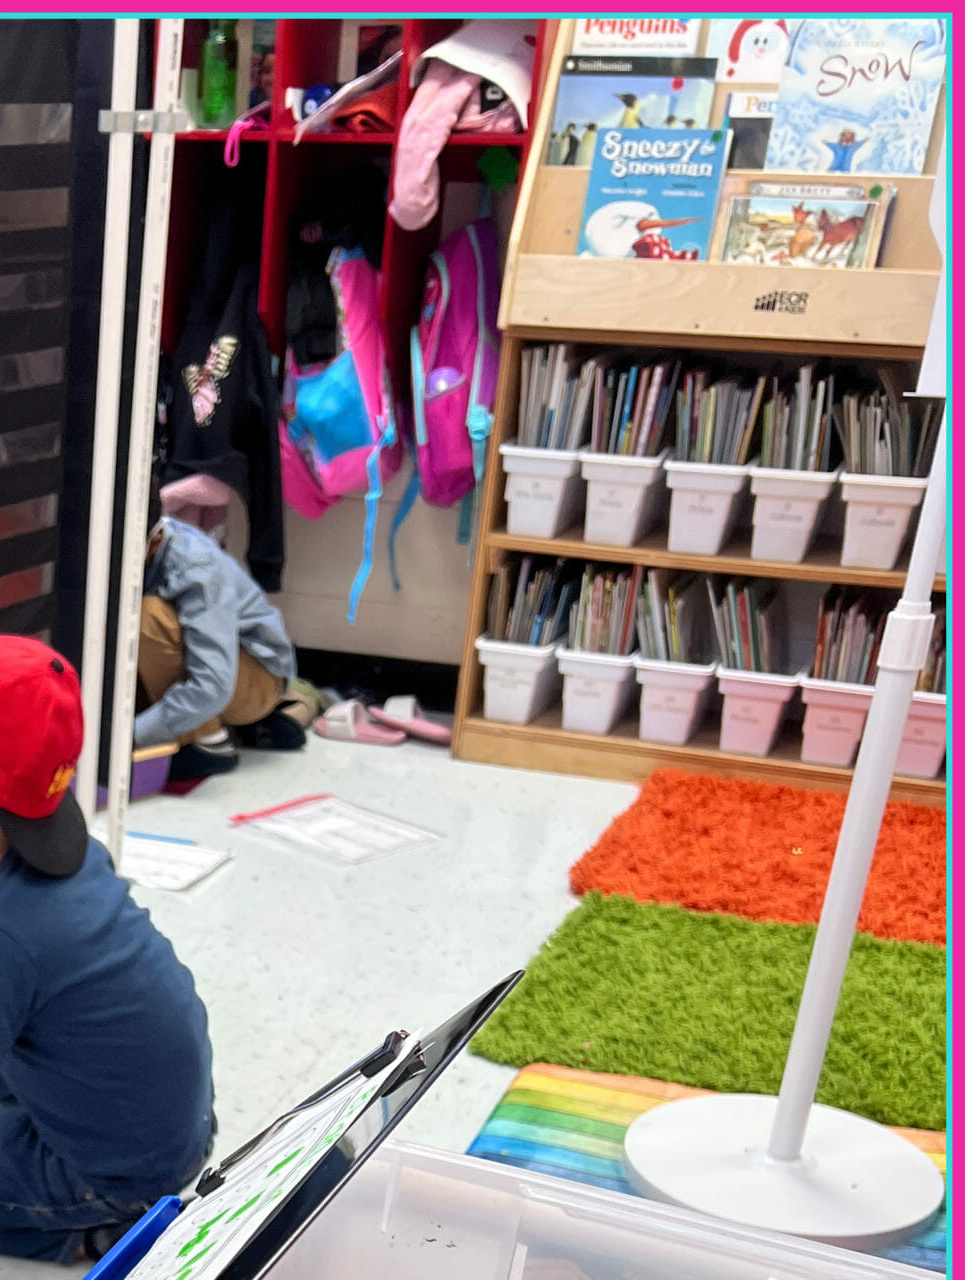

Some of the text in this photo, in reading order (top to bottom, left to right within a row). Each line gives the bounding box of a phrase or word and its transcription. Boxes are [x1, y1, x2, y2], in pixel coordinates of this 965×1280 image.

[577, 59, 633, 72] Smithsonian
[601, 131, 701, 162] Sneezy
[611, 157, 713, 178] Snowman
